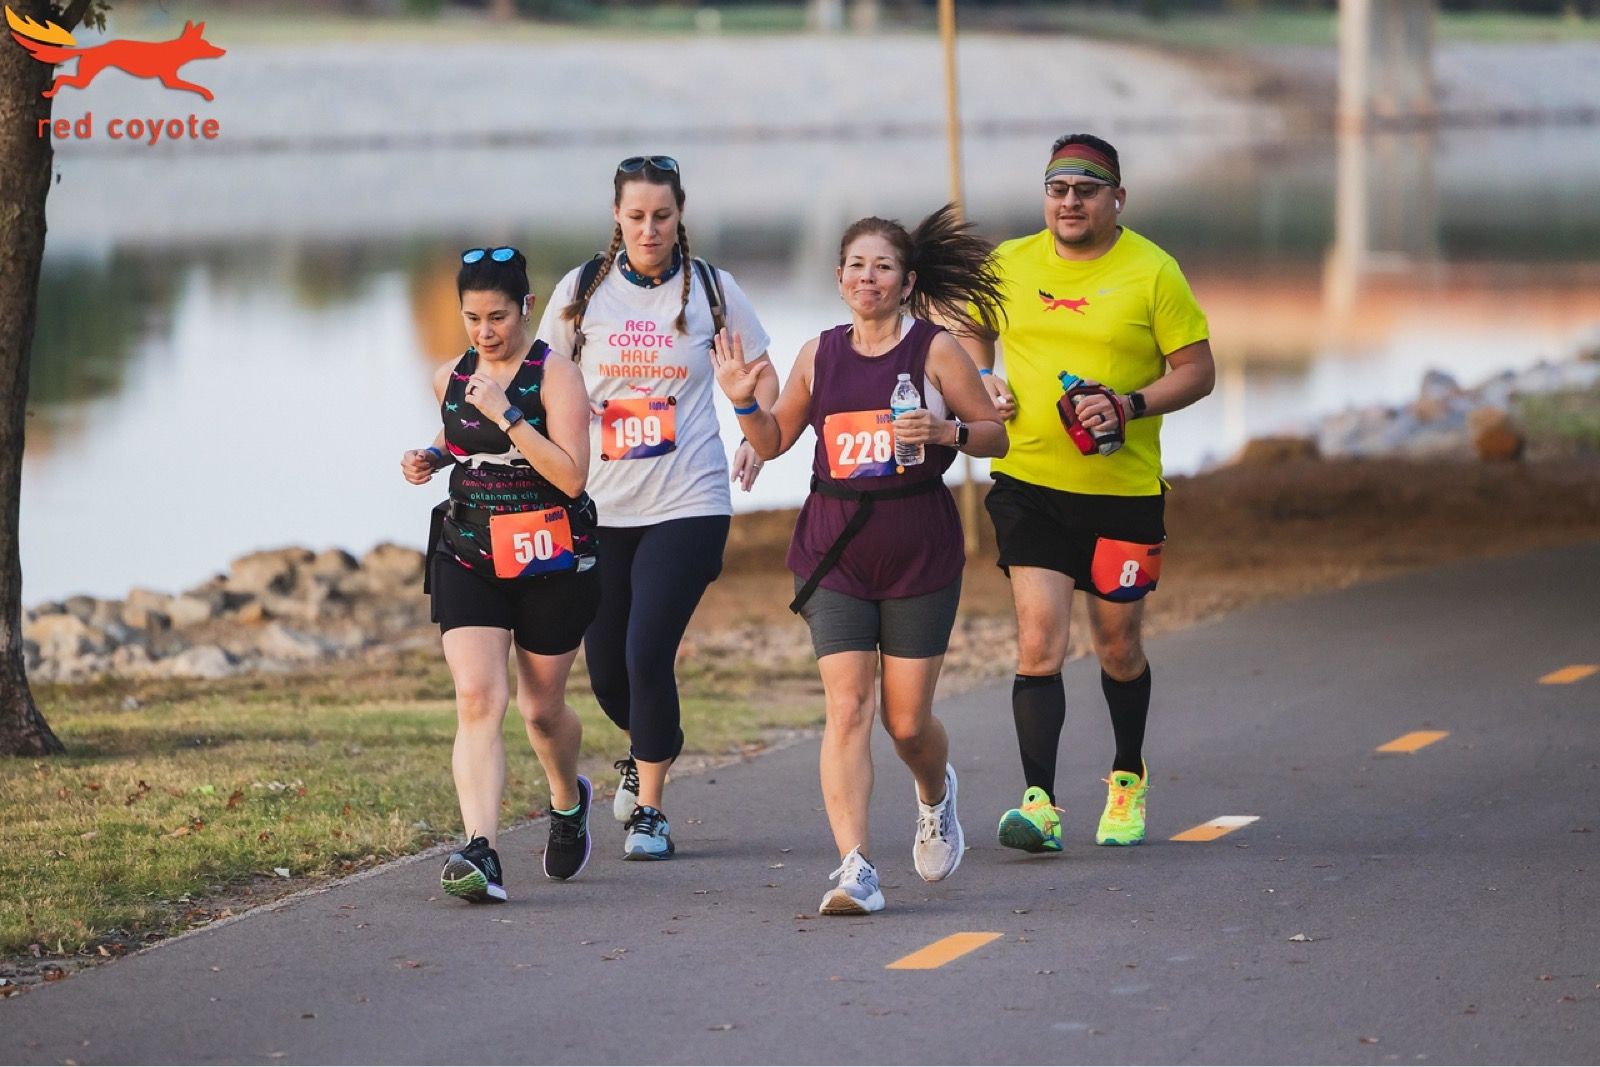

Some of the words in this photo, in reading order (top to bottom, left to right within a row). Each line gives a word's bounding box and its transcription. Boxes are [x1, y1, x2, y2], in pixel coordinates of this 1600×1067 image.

[625, 320, 656, 332] RED
[608, 334, 673, 348] COYOTE
[620, 349, 659, 363] HALF
[598, 363, 688, 379] MARATHON
[610, 415, 662, 448] 199
[836, 429, 892, 465] 228
[470, 491, 518, 501] oklahoma
[513, 529, 553, 564] 50
[1119, 560, 1140, 588] 8
